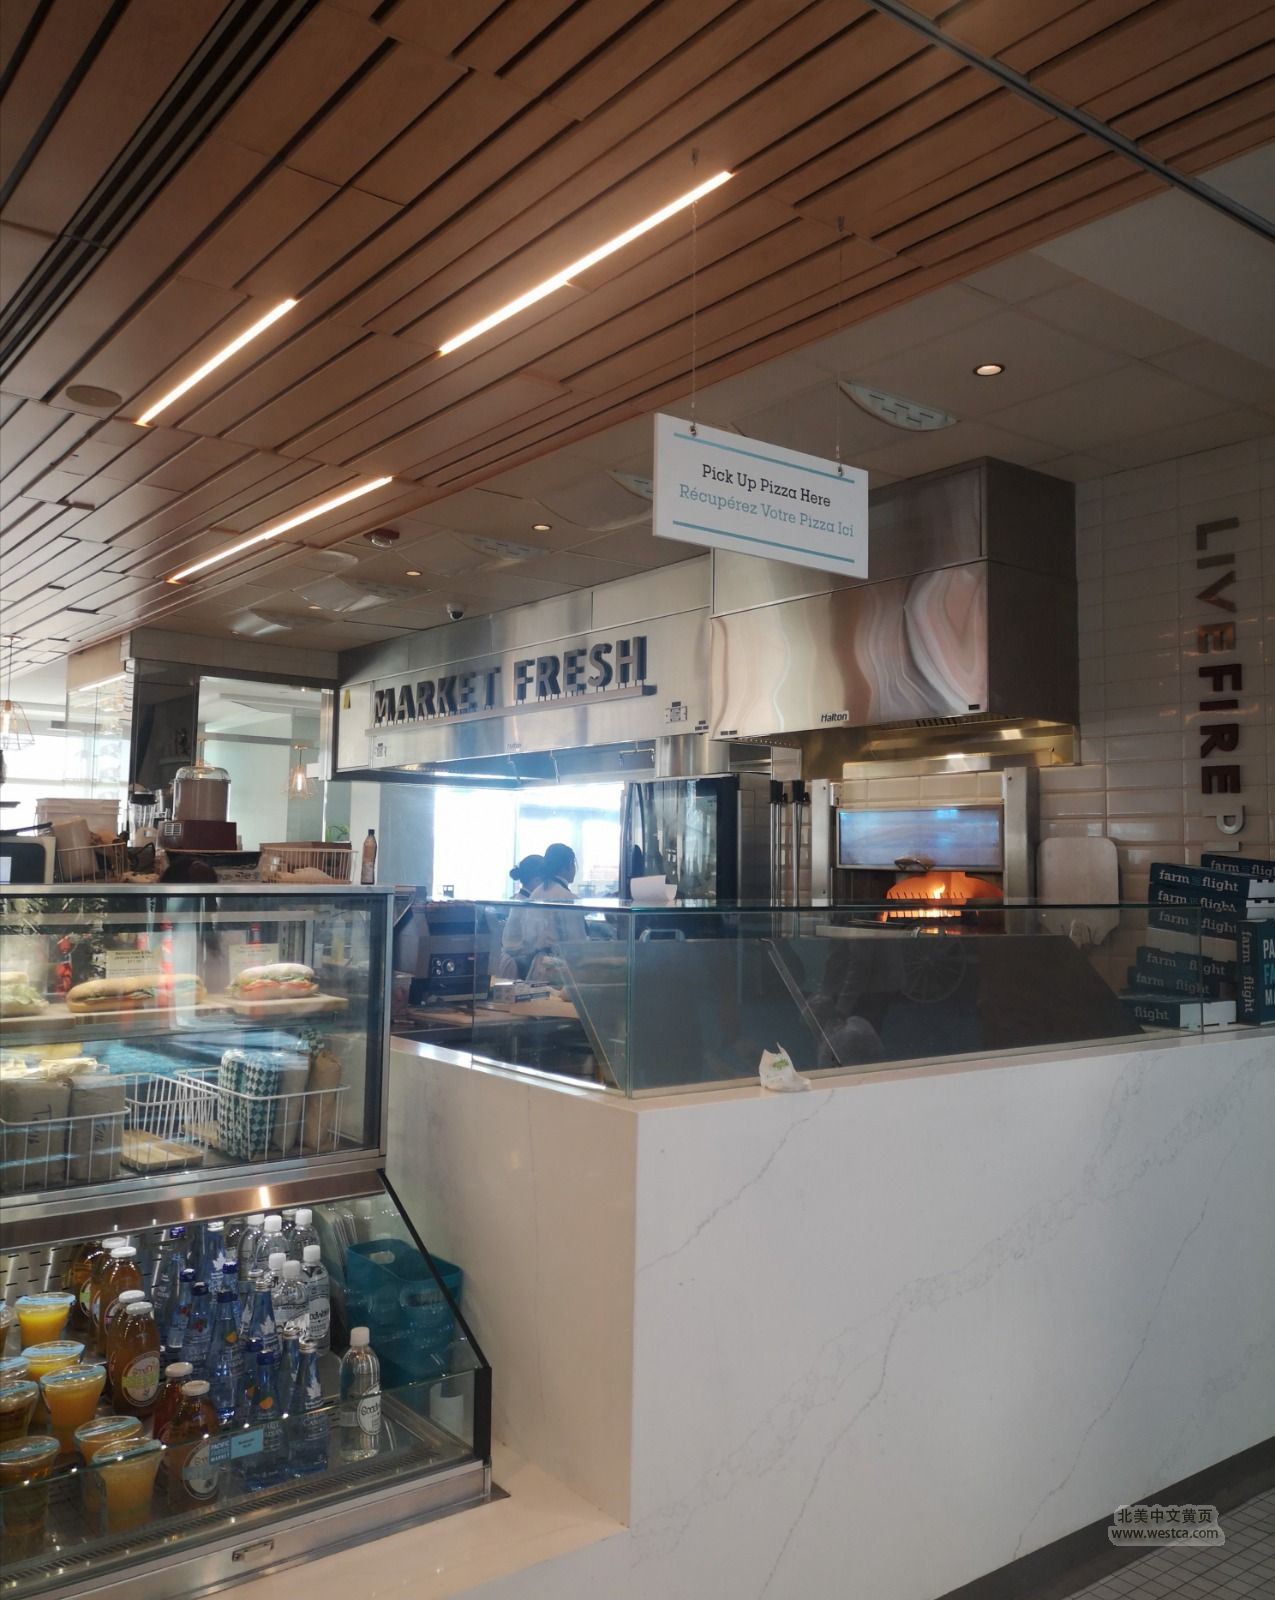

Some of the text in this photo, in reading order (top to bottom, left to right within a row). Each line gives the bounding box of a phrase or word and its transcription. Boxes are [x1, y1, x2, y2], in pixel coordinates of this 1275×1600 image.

[702, 463, 831, 507] Pick Up Pizza Here
[679, 483, 854, 537] Récupérez Votre Pizza Ici
[374, 636, 647, 723] MARKET FRESH
[1210, 860, 1240, 873] farm
[1159, 869, 1239, 892] farm flight
[1158, 890, 1187, 904] farm
[1146, 952, 1226, 976] farm flght
[1136, 972, 1165, 987] farm
[1242, 976, 1255, 1013] flight
[1134, 1006, 1170, 1022] flight
